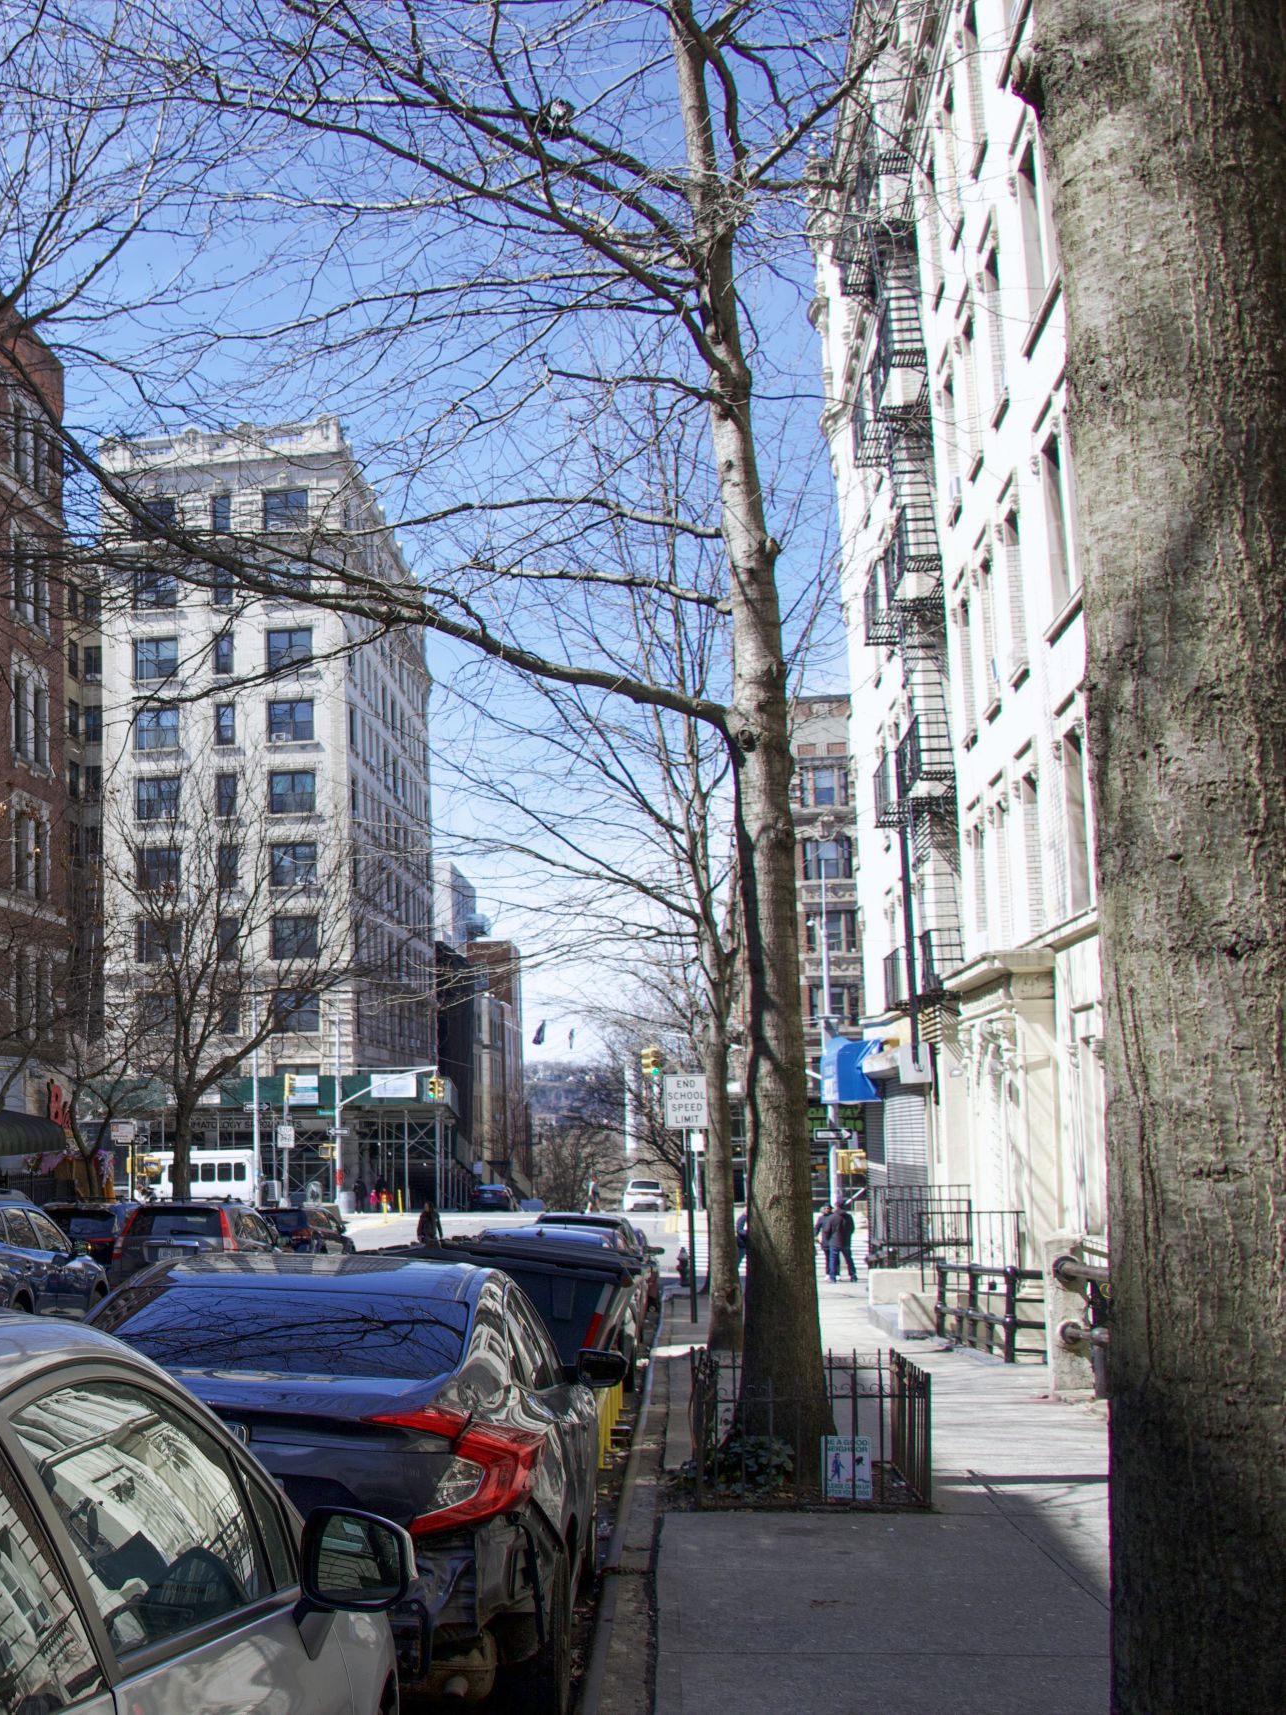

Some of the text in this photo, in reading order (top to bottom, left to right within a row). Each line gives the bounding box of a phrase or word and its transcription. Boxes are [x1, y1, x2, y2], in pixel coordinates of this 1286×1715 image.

[676, 1079, 696, 1089] END
[667, 1091, 706, 1100] SCHOOL
[671, 1103, 703, 1112] SPEED
[675, 1114, 699, 1123] LIMIT
